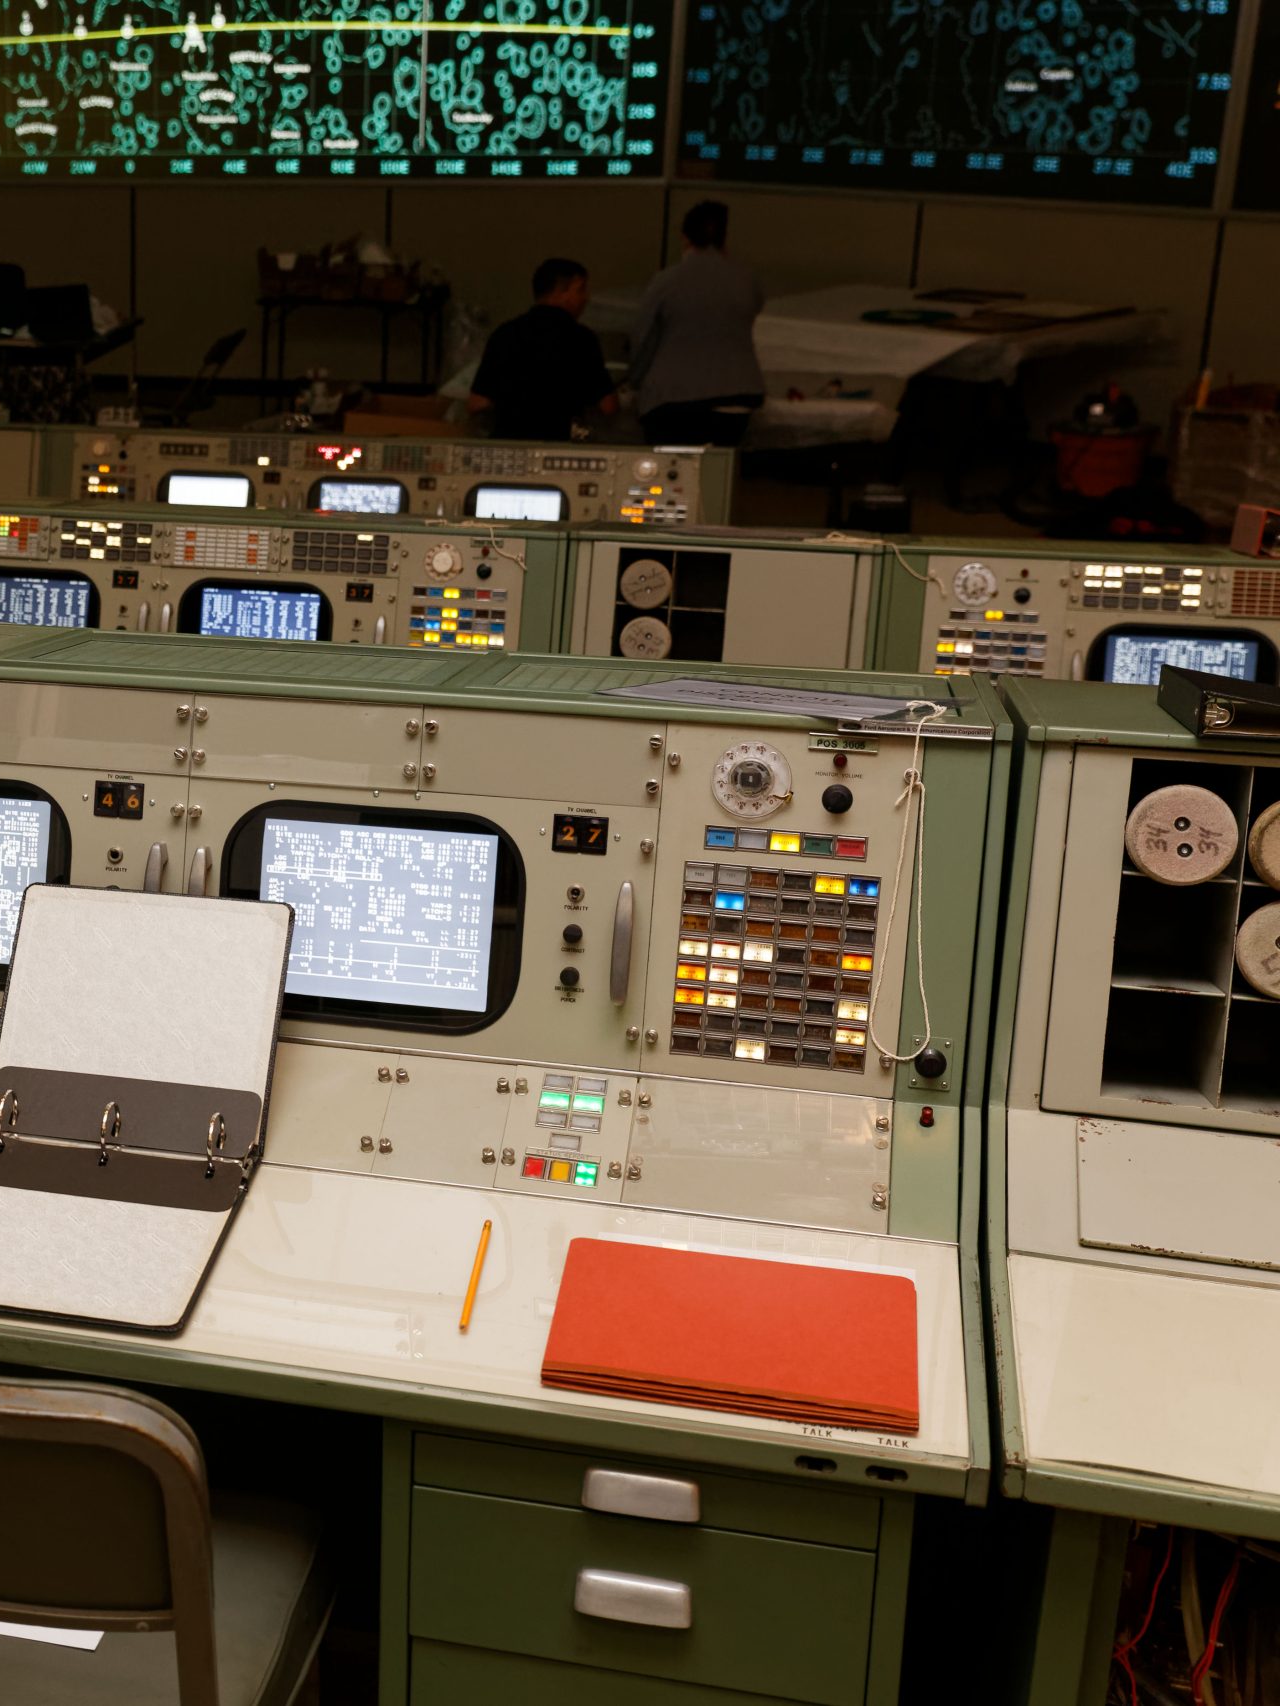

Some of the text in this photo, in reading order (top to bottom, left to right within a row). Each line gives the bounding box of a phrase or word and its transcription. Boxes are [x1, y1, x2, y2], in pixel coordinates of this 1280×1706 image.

[958, 728, 991, 736] Corporation
[816, 738, 838, 748] POS
[576, 807, 597, 815] CHANNEL
[389, 834, 423, 842] DIGITALS
[1145, 823, 1171, 853] 34
[1198, 825, 1224, 858] 34
[560, 946, 585, 954] CONTRAST
[554, 985, 585, 993] BRIGHTNESS
[802, 1427, 910, 1449] TALK TALK
